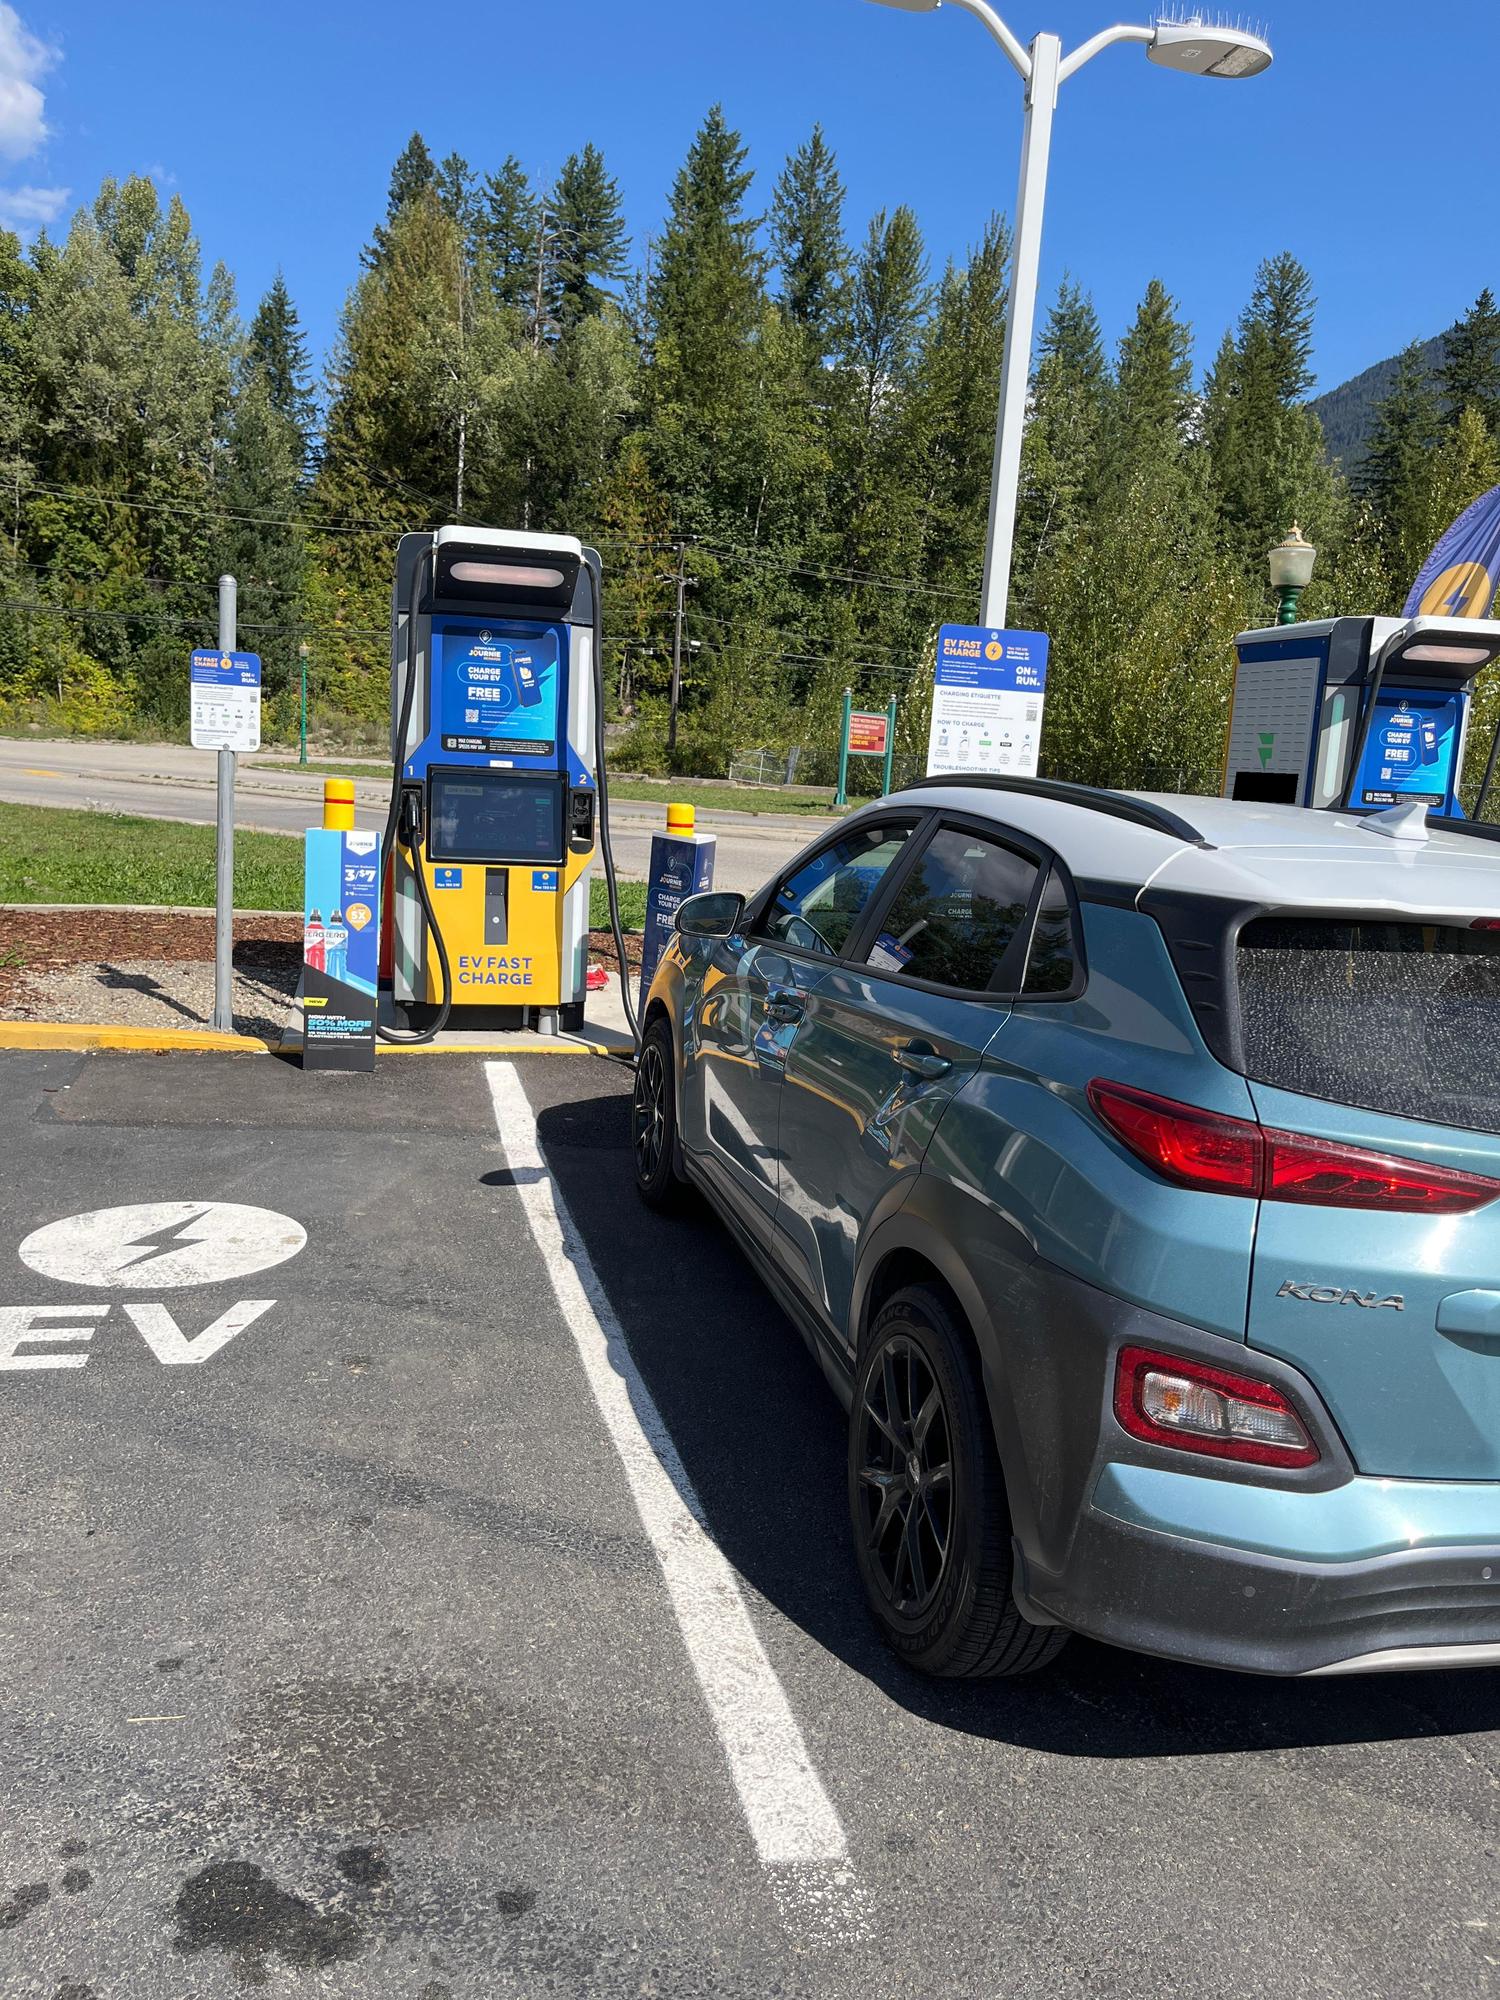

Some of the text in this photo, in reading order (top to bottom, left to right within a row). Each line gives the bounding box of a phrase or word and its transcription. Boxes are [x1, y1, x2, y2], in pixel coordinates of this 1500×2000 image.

[944, 639, 982, 649] EV FAST
[469, 650, 502, 658] JOURNIE
[944, 648, 981, 658] CHARGE
[468, 667, 501, 675] CHARGE
[1016, 667, 1031, 675] ON
[468, 687, 501, 698] FREE
[1386, 749, 1409, 758] FREE
[407, 765, 414, 776] 1
[579, 774, 587, 785] 2
[658, 894, 681, 904] CHARGE
[657, 913, 676, 926] FRE
[459, 956, 532, 969] EV FAST
[458, 972, 533, 985] CHARGE
[308, 1019, 336, 1027] 50%
[1275, 1279, 1405, 1312] KONA
[0, 1299, 278, 1371] EV
